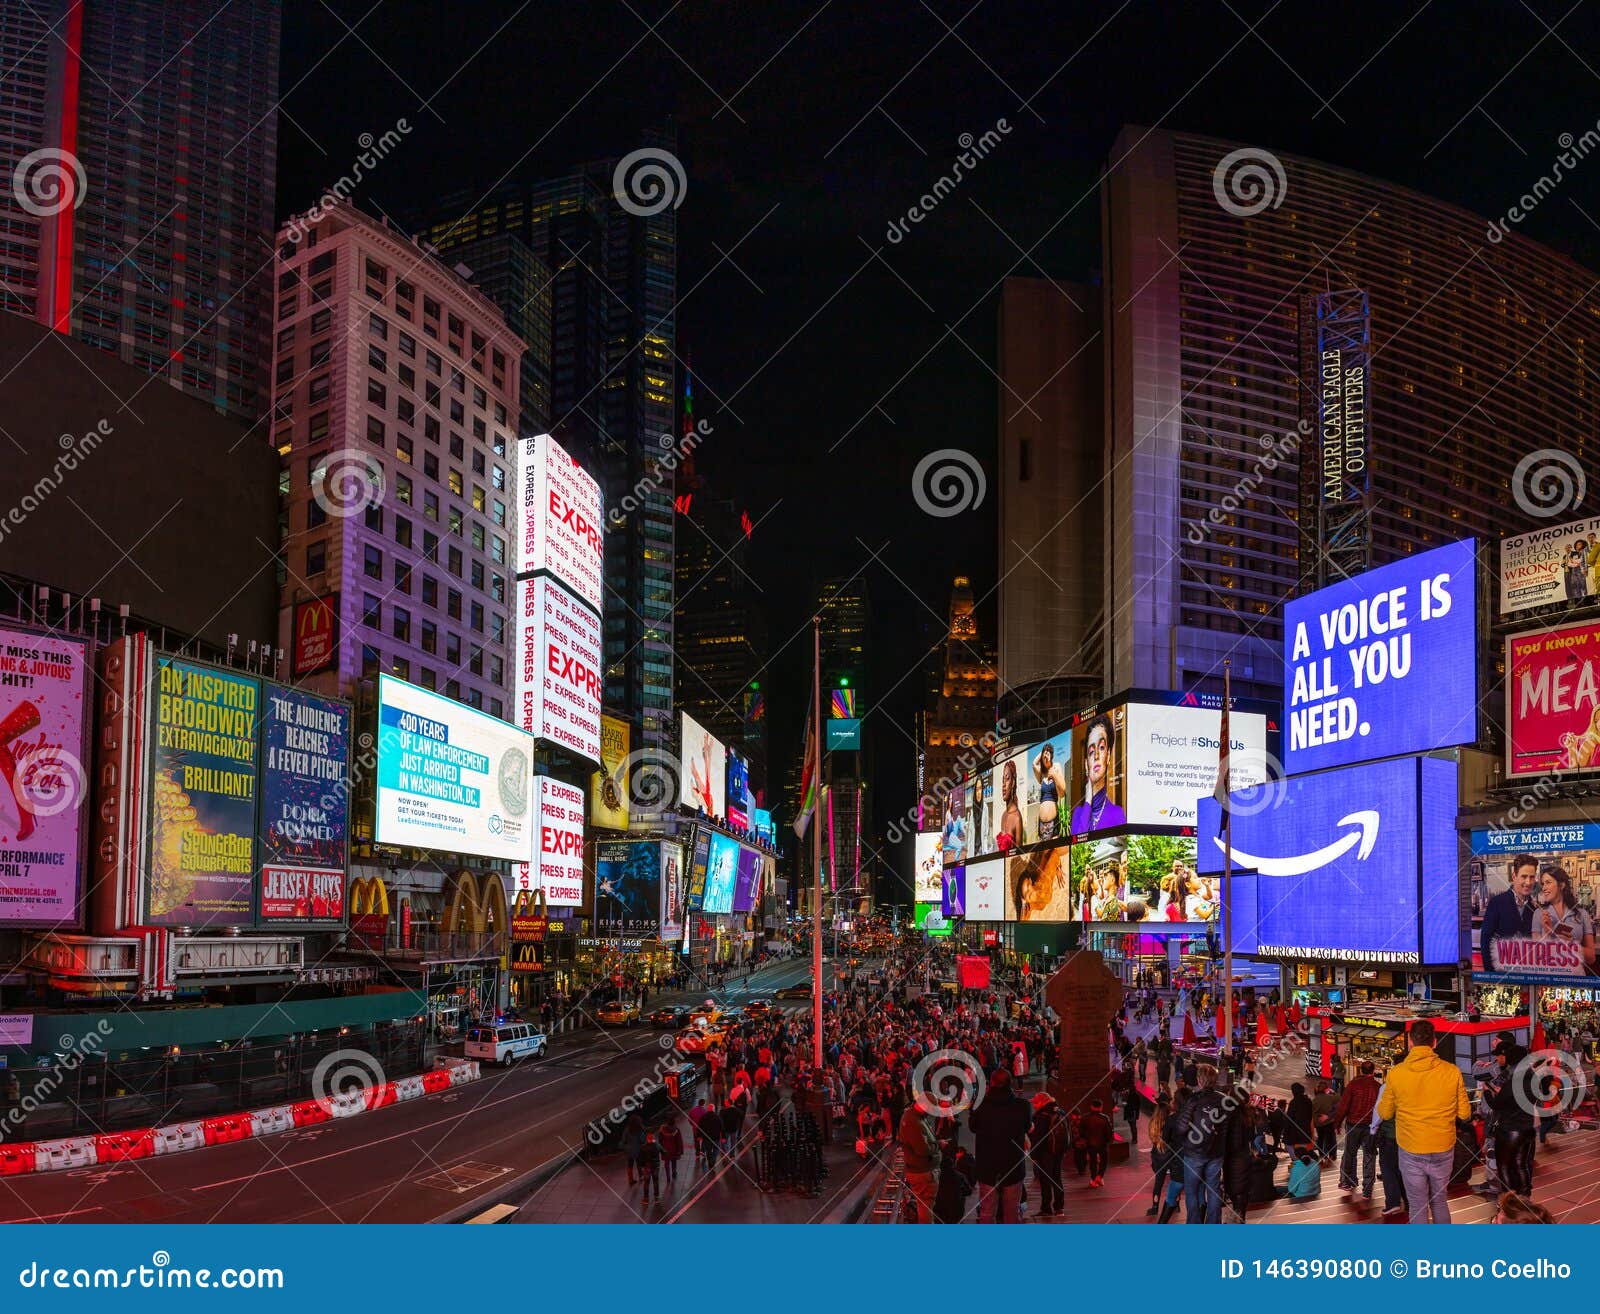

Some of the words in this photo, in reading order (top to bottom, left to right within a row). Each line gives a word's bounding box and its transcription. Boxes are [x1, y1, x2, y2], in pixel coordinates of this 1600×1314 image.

[1323, 350, 1341, 399] EAGLE
[1345, 366, 1365, 473] OUTFITTERS
[1323, 403, 1342, 500] AMERICAN
[525, 465, 535, 508] EXPRESS
[558, 465, 588, 499] EXPRESS
[573, 497, 600, 528] EXPRESS
[525, 509, 535, 555] EXPRESS
[557, 526, 587, 558] EXPRESS
[1506, 538, 1524, 550] SO
[1528, 523, 1584, 544] WRONG
[1505, 558, 1527, 569] THAT
[1527, 549, 1560, 564] GOES
[1510, 551, 1525, 560] THE
[1527, 541, 1555, 556] PLAY
[556, 563, 586, 594] EXPRESS
[572, 558, 600, 587] EXPRESS
[1504, 562, 1560, 580] WRONG
[555, 611, 587, 639] EXPRESS
[572, 604, 599, 632] EXPRESS
[1293, 622, 1310, 662] A
[1320, 586, 1407, 650] VOICE
[1420, 573, 1452, 622] IS
[302, 633, 328, 646] OPEN
[304, 642, 325, 658] 24
[1516, 642, 1541, 657] YOU
[1545, 634, 1589, 651] KNOW
[7, 646, 39, 659] MISS
[42, 651, 72, 665] THIS
[524, 627, 534, 683] EXPRESS
[571, 641, 599, 668] EXPRESS
[2, 673, 34, 688] HIT!
[1291, 656, 1339, 707] ALL
[1349, 633, 1412, 689] YOU
[187, 671, 255, 711] INSPIRED
[555, 684, 586, 709] EXPRESS
[160, 694, 255, 739] BROADWAY
[296, 704, 342, 735] AUDIENCE
[400, 712, 417, 732] 400
[417, 718, 445, 741] YEARS
[570, 712, 598, 737] EXPRESS
[1290, 697, 1371, 751] NEED.
[285, 725, 329, 755] REACHES
[400, 731, 412, 750] OF
[413, 735, 432, 755] LAW
[433, 740, 487, 773] ENFORCEMENT
[554, 727, 585, 750] EXPRESS
[1151, 733, 1187, 747] Project
[1192, 736, 1245, 751] #ShoUs
[268, 747, 276, 769] A
[279, 749, 308, 776] FEVER
[400, 752, 422, 772] JUST
[423, 759, 457, 782] ARRIVED
[1148, 760, 1164, 769] Dove
[1180, 763, 1201, 771] women
[400, 774, 408, 790] IN
[410, 776, 465, 805] WASHINGTON,
[1138, 769, 1163, 779] building
[1165, 770, 1174, 778] the
[1176, 771, 1198, 779] world's
[1240, 775, 1257, 784] library
[1187, 781, 1208, 789] beauty
[398, 797, 411, 805] NOW
[551, 784, 582, 806] EXPRESS
[282, 803, 327, 824] DONNA
[398, 806, 409, 814] GET
[410, 808, 426, 817] YOUR
[427, 812, 448, 821] TICKETS
[541, 802, 566, 820] PRESS
[1169, 807, 1196, 818] Dove
[276, 820, 334, 842] SUMMER
[1488, 834, 1518, 846] JOEY
[1521, 831, 1584, 844] McINTYRE
[24, 865, 30, 877] 7
[540, 863, 565, 878] PRESS
[264, 871, 311, 900] JERSEY
[312, 874, 341, 904] BOYS
[550, 886, 581, 900] EXPRESS
[512, 920, 546, 928] McDonald's
[1258, 946, 1306, 958] AMERICAN
[1310, 948, 1342, 960] EAGLE
[1345, 949, 1419, 964] OUTFITTERS
[1497, 940, 1580, 967] WAITRESS
